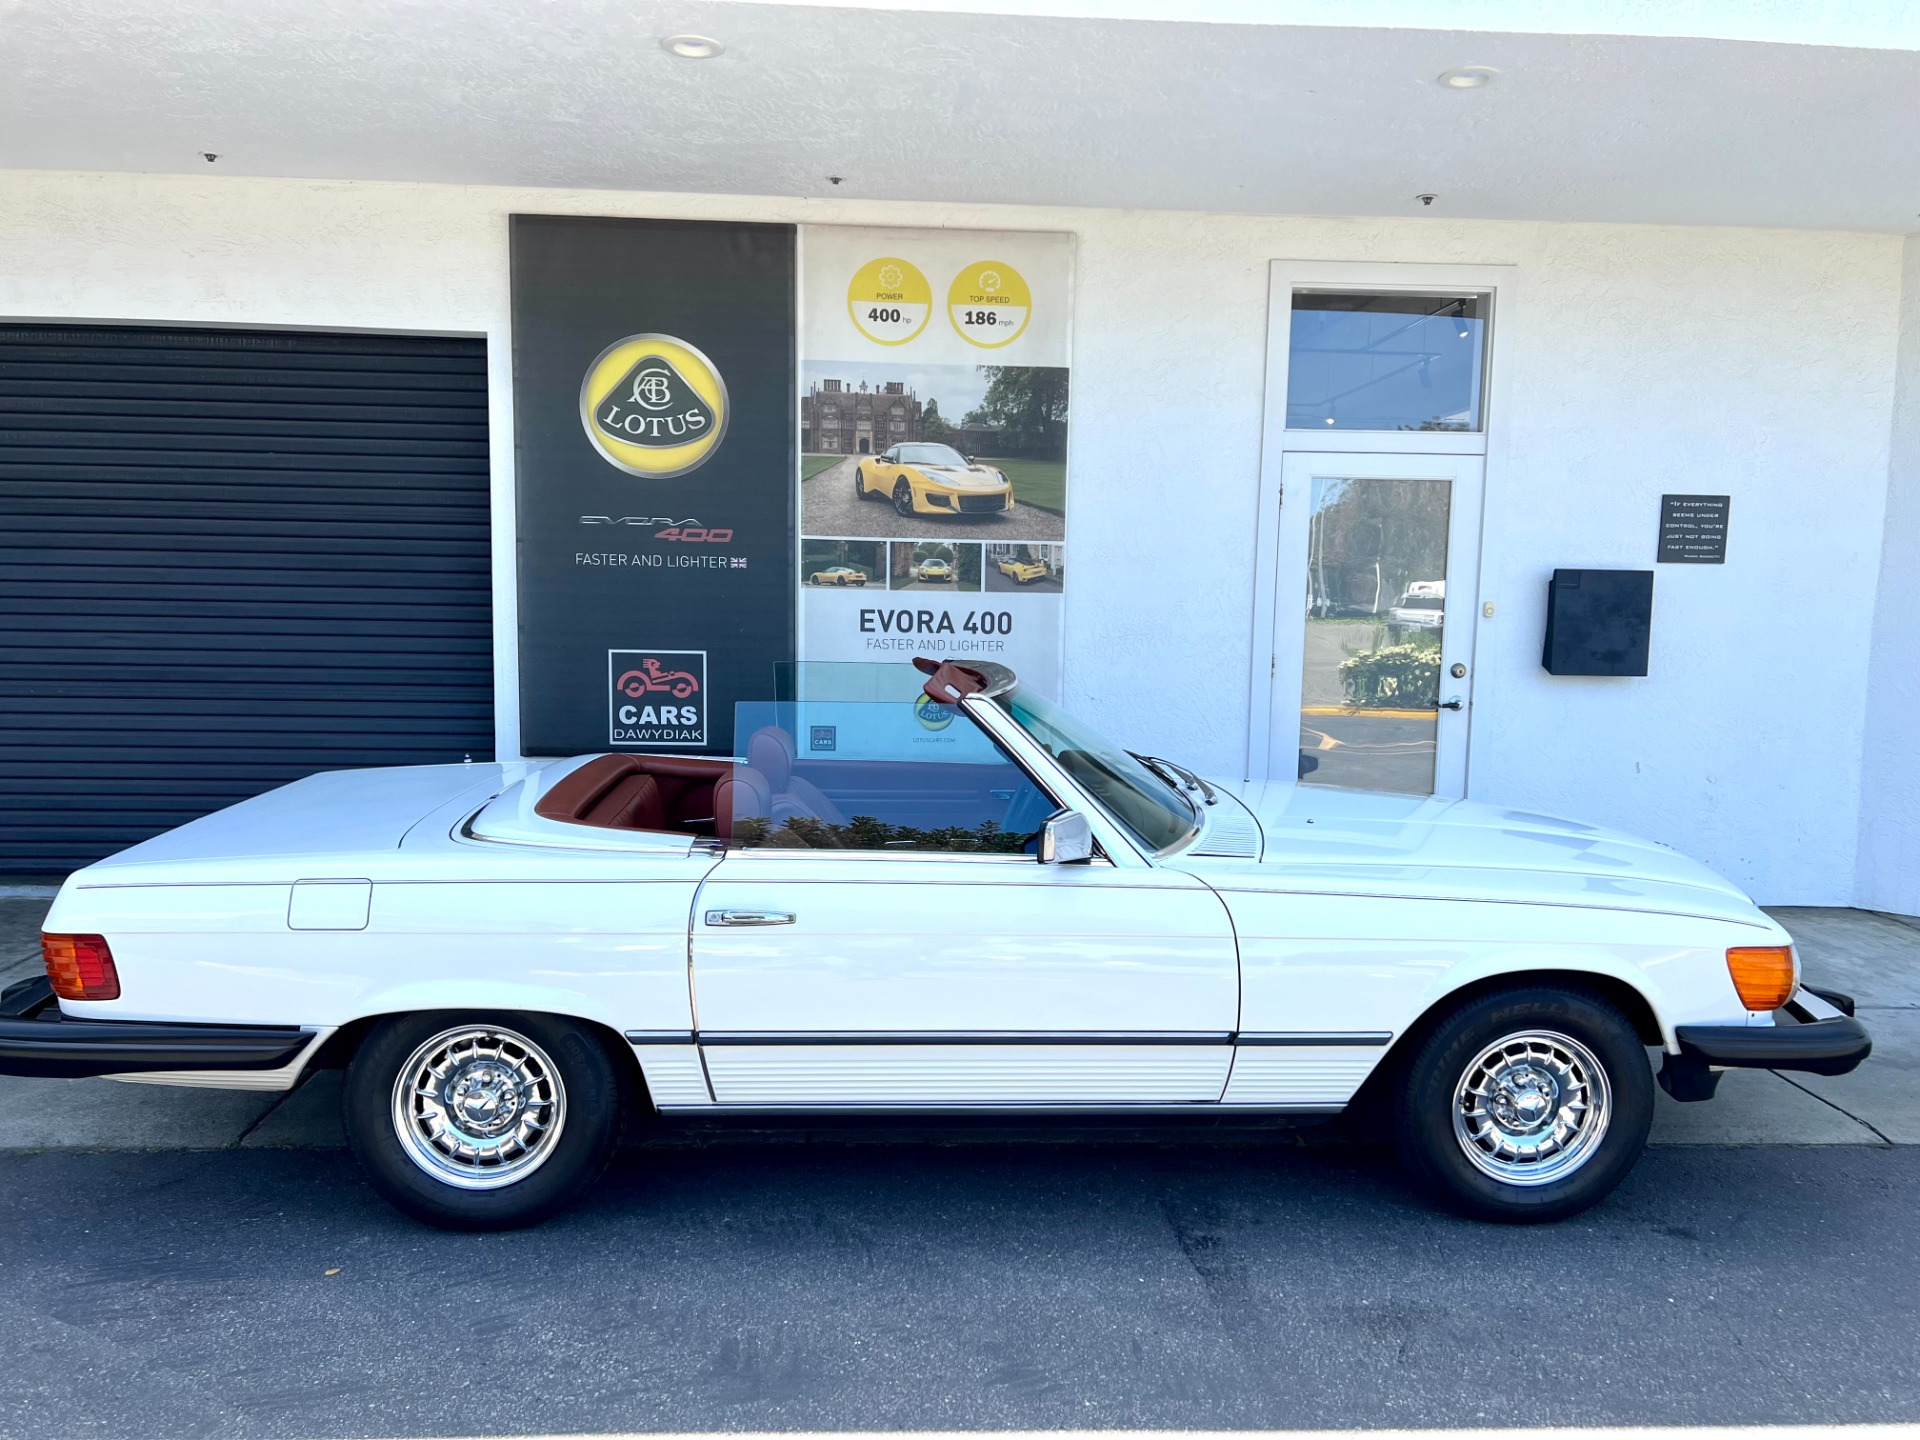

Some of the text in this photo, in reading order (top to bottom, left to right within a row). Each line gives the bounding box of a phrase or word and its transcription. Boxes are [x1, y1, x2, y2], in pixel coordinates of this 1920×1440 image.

[876, 292, 903, 300] POWER
[969, 295, 1010, 304] TOP SPEED
[868, 307, 912, 324] 400 hp
[964, 310, 1014, 327] 186 mph
[603, 405, 706, 437] LOTUS
[579, 515, 704, 527] EVORA
[654, 528, 734, 543] 400
[575, 553, 727, 569] FASTER AND LIGHTER
[860, 609, 1013, 635] EVORA 400
[866, 638, 1004, 652] FASTER AND LIGHTER
[618, 705, 698, 726] CARS
[920, 710, 949, 720] LOTUS
[614, 729, 702, 740] DAWYDIAK
